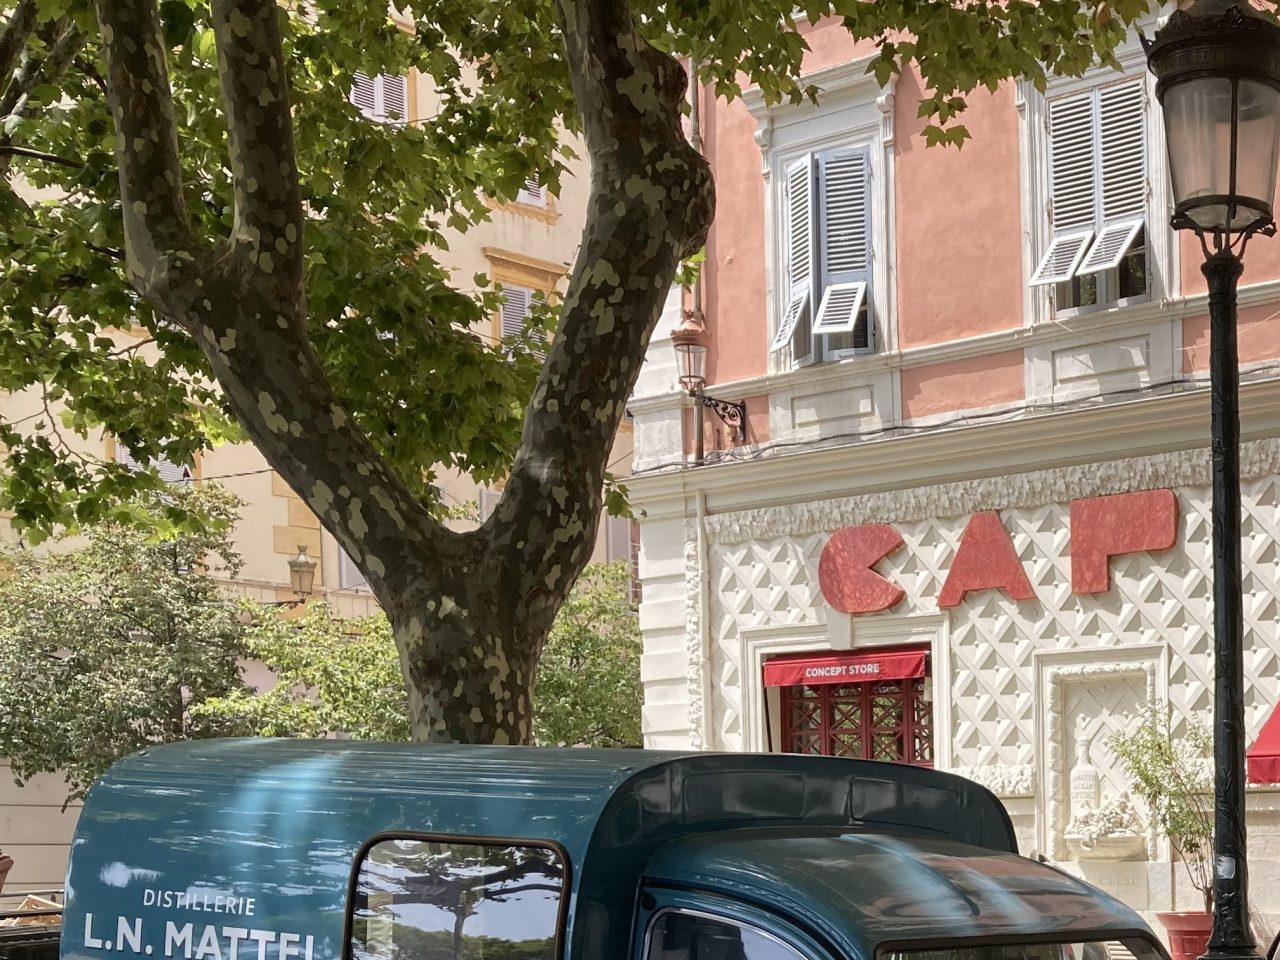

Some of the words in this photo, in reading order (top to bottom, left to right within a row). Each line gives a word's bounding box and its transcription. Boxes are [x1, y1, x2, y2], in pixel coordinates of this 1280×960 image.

[817, 487, 1180, 614] CAP
[805, 665, 847, 678] CONCEPT
[848, 663, 880, 675] STORE
[143, 888, 256, 916] DISTILLERIE
[84, 912, 153, 956] L.N.
